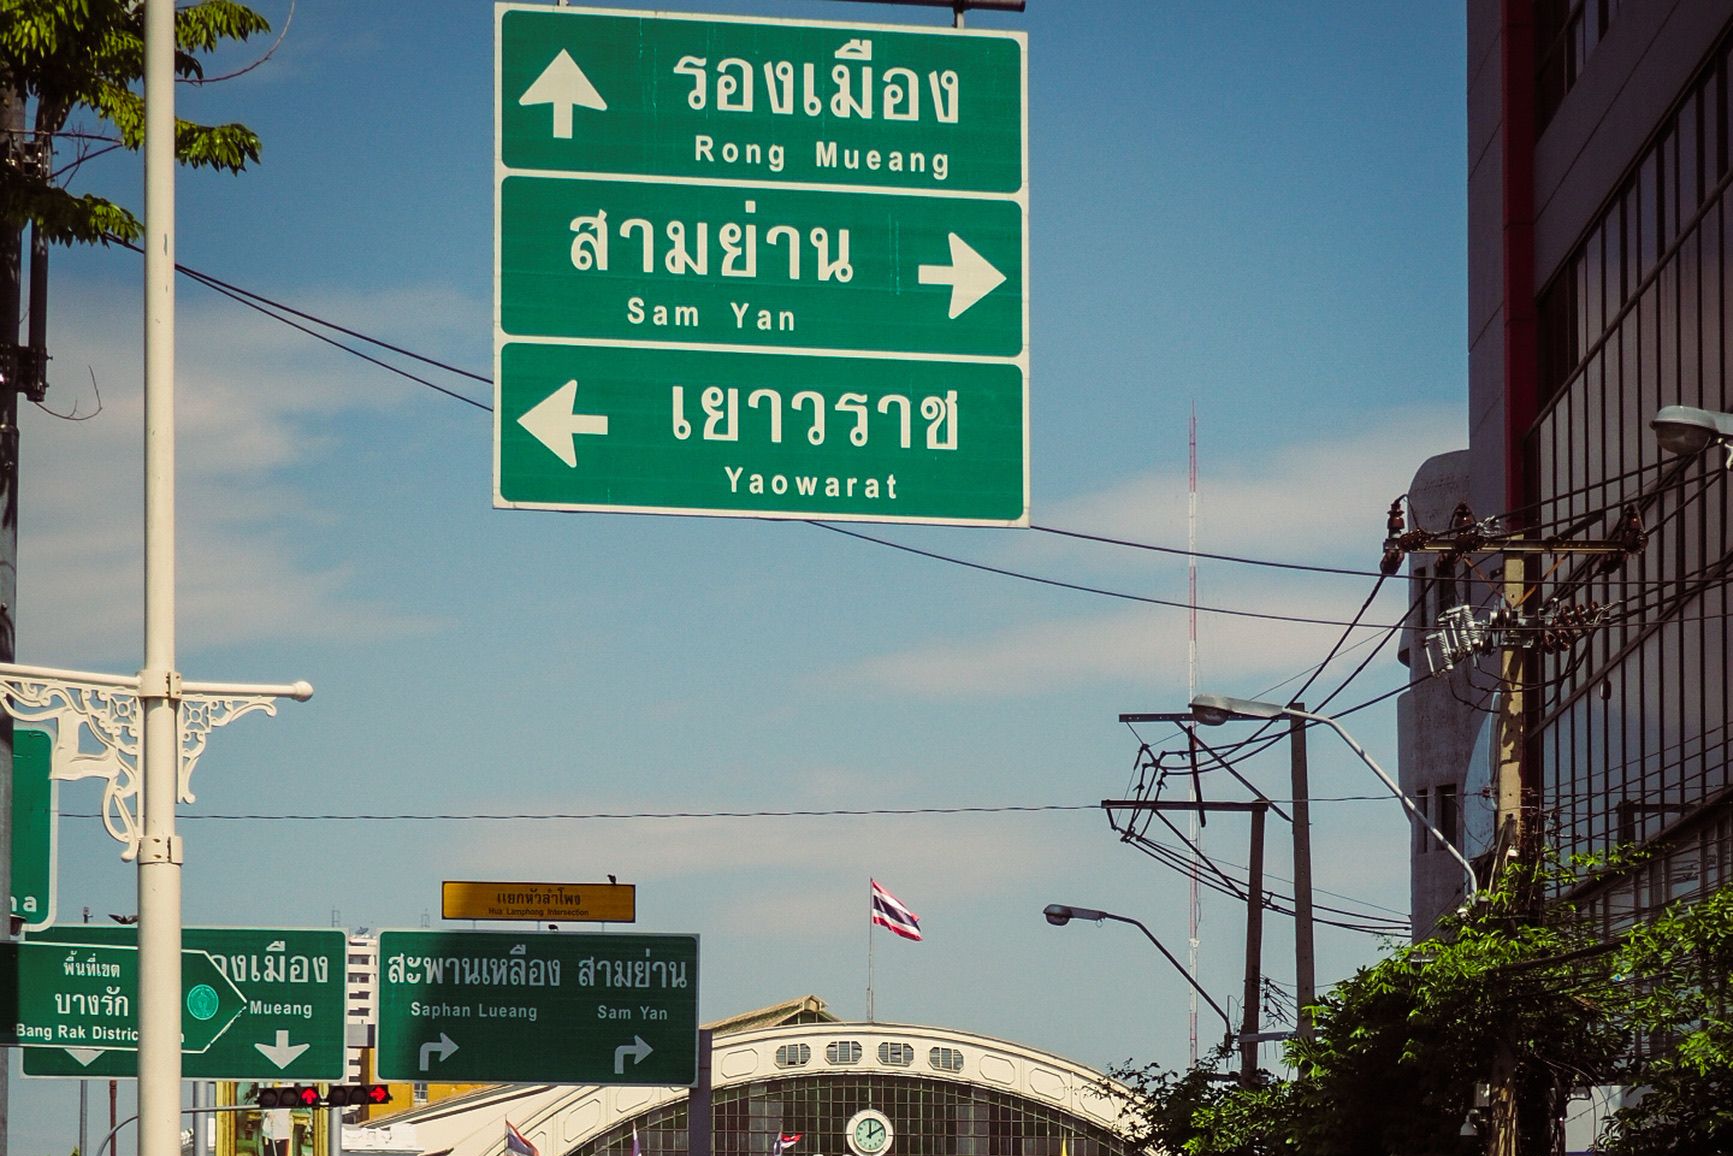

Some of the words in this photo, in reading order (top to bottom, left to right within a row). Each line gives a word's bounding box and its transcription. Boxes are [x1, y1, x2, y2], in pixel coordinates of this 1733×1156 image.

[673, 39, 959, 124] รองเมือง
[695, 135, 785, 172] Rong
[815, 141, 949, 180] Mueang
[569, 200, 854, 283] สามย่าน
[627, 297, 699, 328] Sam
[731, 302, 796, 331] Yan
[672, 385, 958, 450] เยาวราช
[724, 466, 898, 500] Yaowarat
[488, 907, 503, 915] Hua
[506, 907, 545, 917] Lamphong
[547, 908, 589, 917] Intersection
[497, 887, 581, 905] แยกหัวลำโพง
[63, 950, 120, 978] พื้นที่เขต
[388, 944, 561, 987] สะพานเหลือง
[578, 948, 688, 988] สามย่าน
[55, 986, 129, 1016] บางรัก
[250, 1000, 312, 1018] Mueang
[411, 1001, 471, 1019] Saphan
[479, 1003, 537, 1021] Lueang
[597, 1005, 632, 1019] Sam
[640, 1006, 668, 1020] Yan
[16, 1023, 52, 1040] Bang
[58, 1025, 86, 1039] Rak
[92, 1026, 139, 1041] Distric
